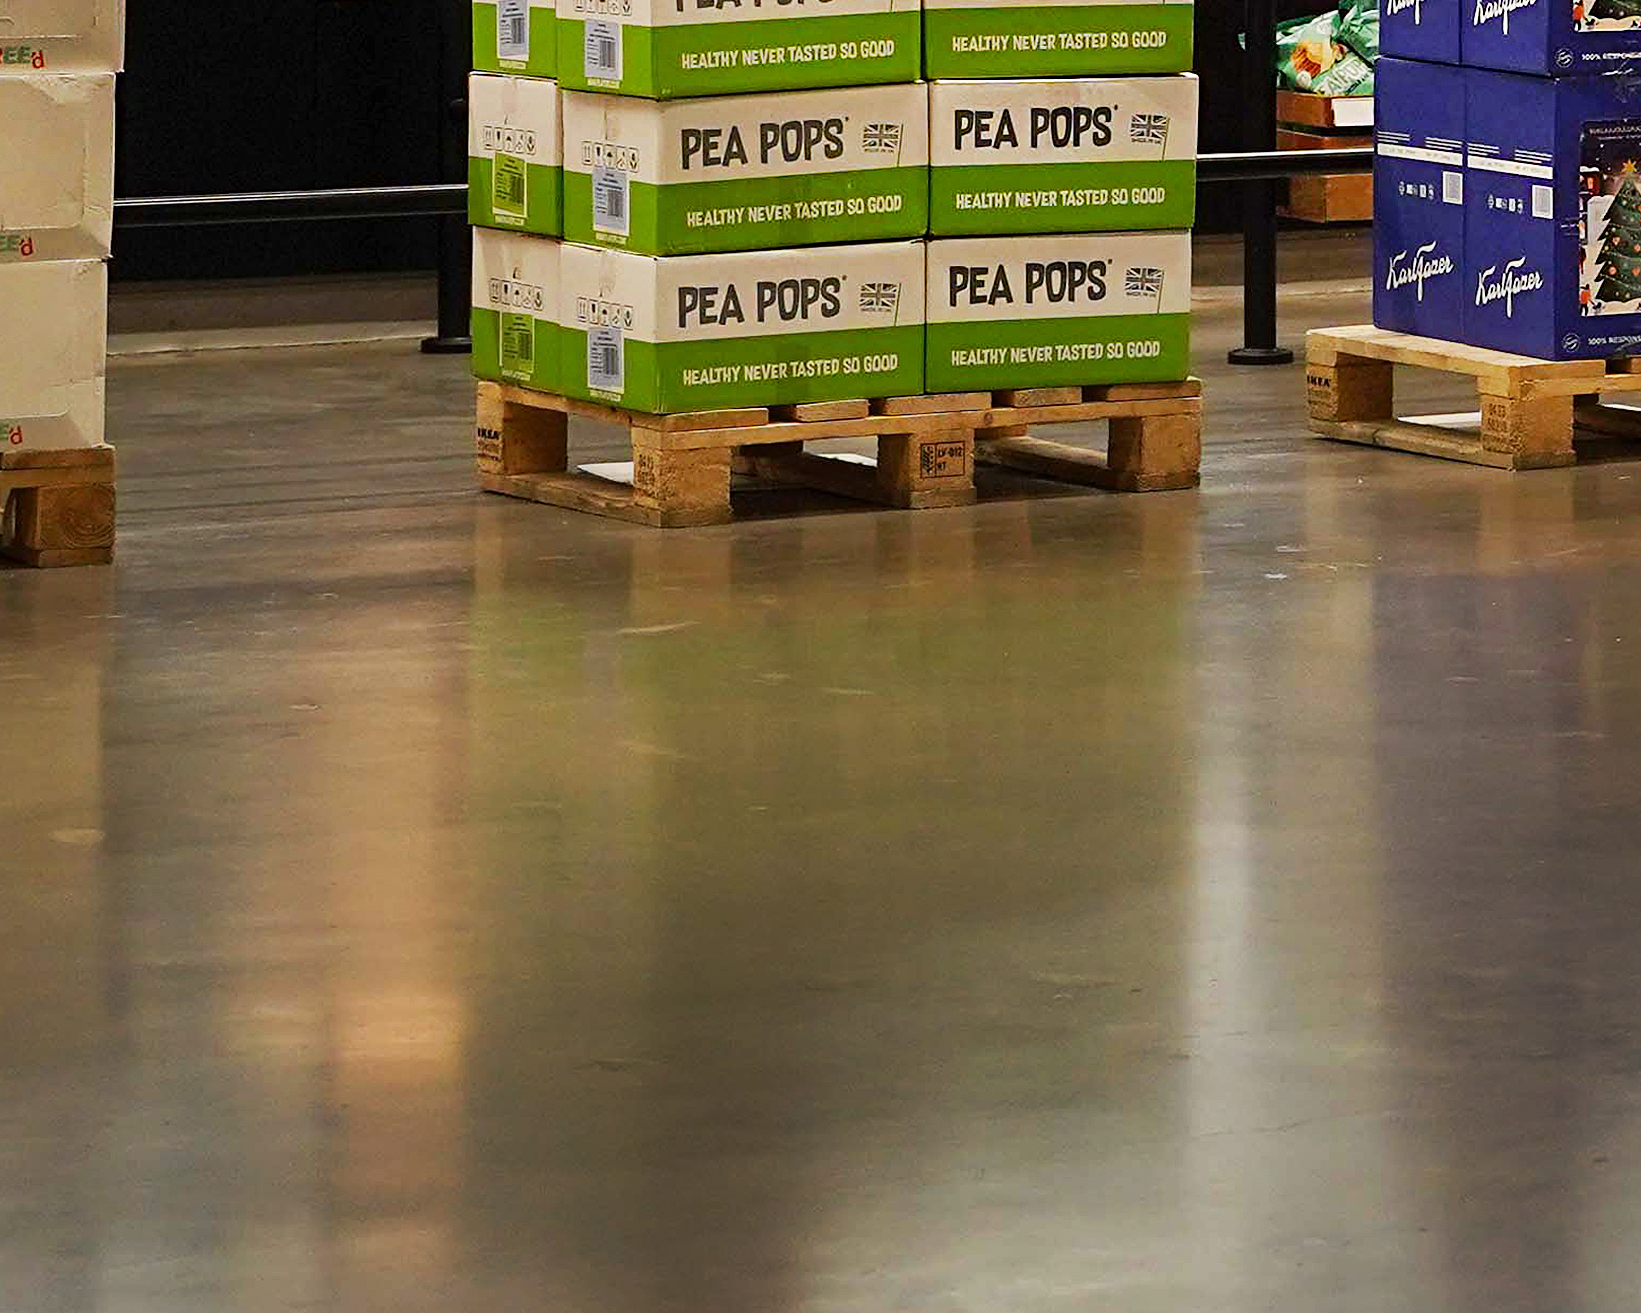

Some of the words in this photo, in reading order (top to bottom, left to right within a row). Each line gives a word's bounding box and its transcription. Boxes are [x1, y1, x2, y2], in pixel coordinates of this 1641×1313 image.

[681, 125, 748, 170] PEA
[759, 119, 844, 164] POPS
[953, 109, 1018, 150] PEA
[1030, 106, 1112, 148] POPS
[678, 282, 745, 328] PEA
[756, 276, 841, 322] POPS
[949, 264, 1013, 308] PEA
[1025, 259, 1107, 303] POPS
